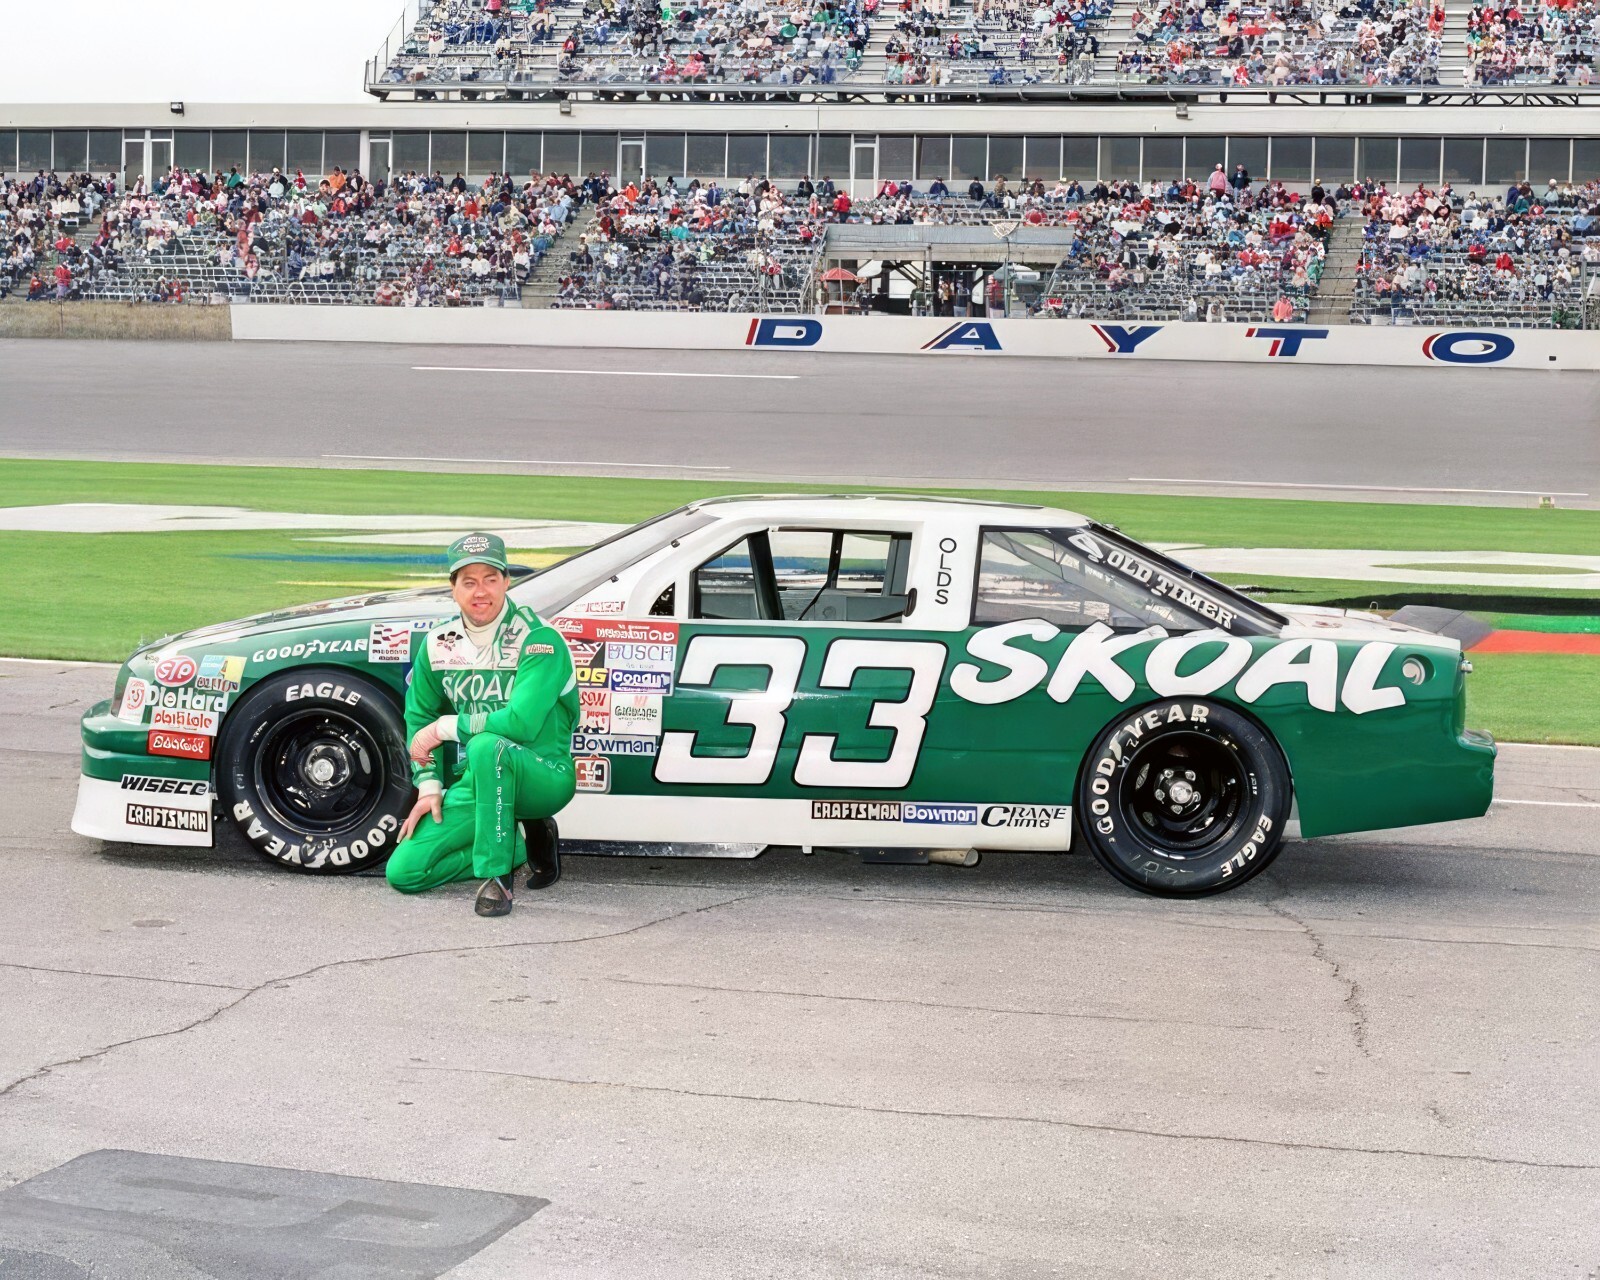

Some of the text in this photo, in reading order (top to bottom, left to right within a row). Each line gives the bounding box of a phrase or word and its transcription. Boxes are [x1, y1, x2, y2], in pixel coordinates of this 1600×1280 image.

[935, 537, 957, 605] OLDS
[1106, 550, 1235, 630] OLD TIMER
[949, 617, 1406, 715] SKOAL
[286, 682, 362, 706] EAGLE
[572, 734, 655, 753] Bowman
[1092, 704, 1210, 835] GOODYEAR
[127, 804, 207, 831] CRAFTSMAN
[813, 802, 901, 821] CRAFTSMAN
[903, 804, 977, 824] Bowman
[1219, 814, 1273, 878] EAGLE
